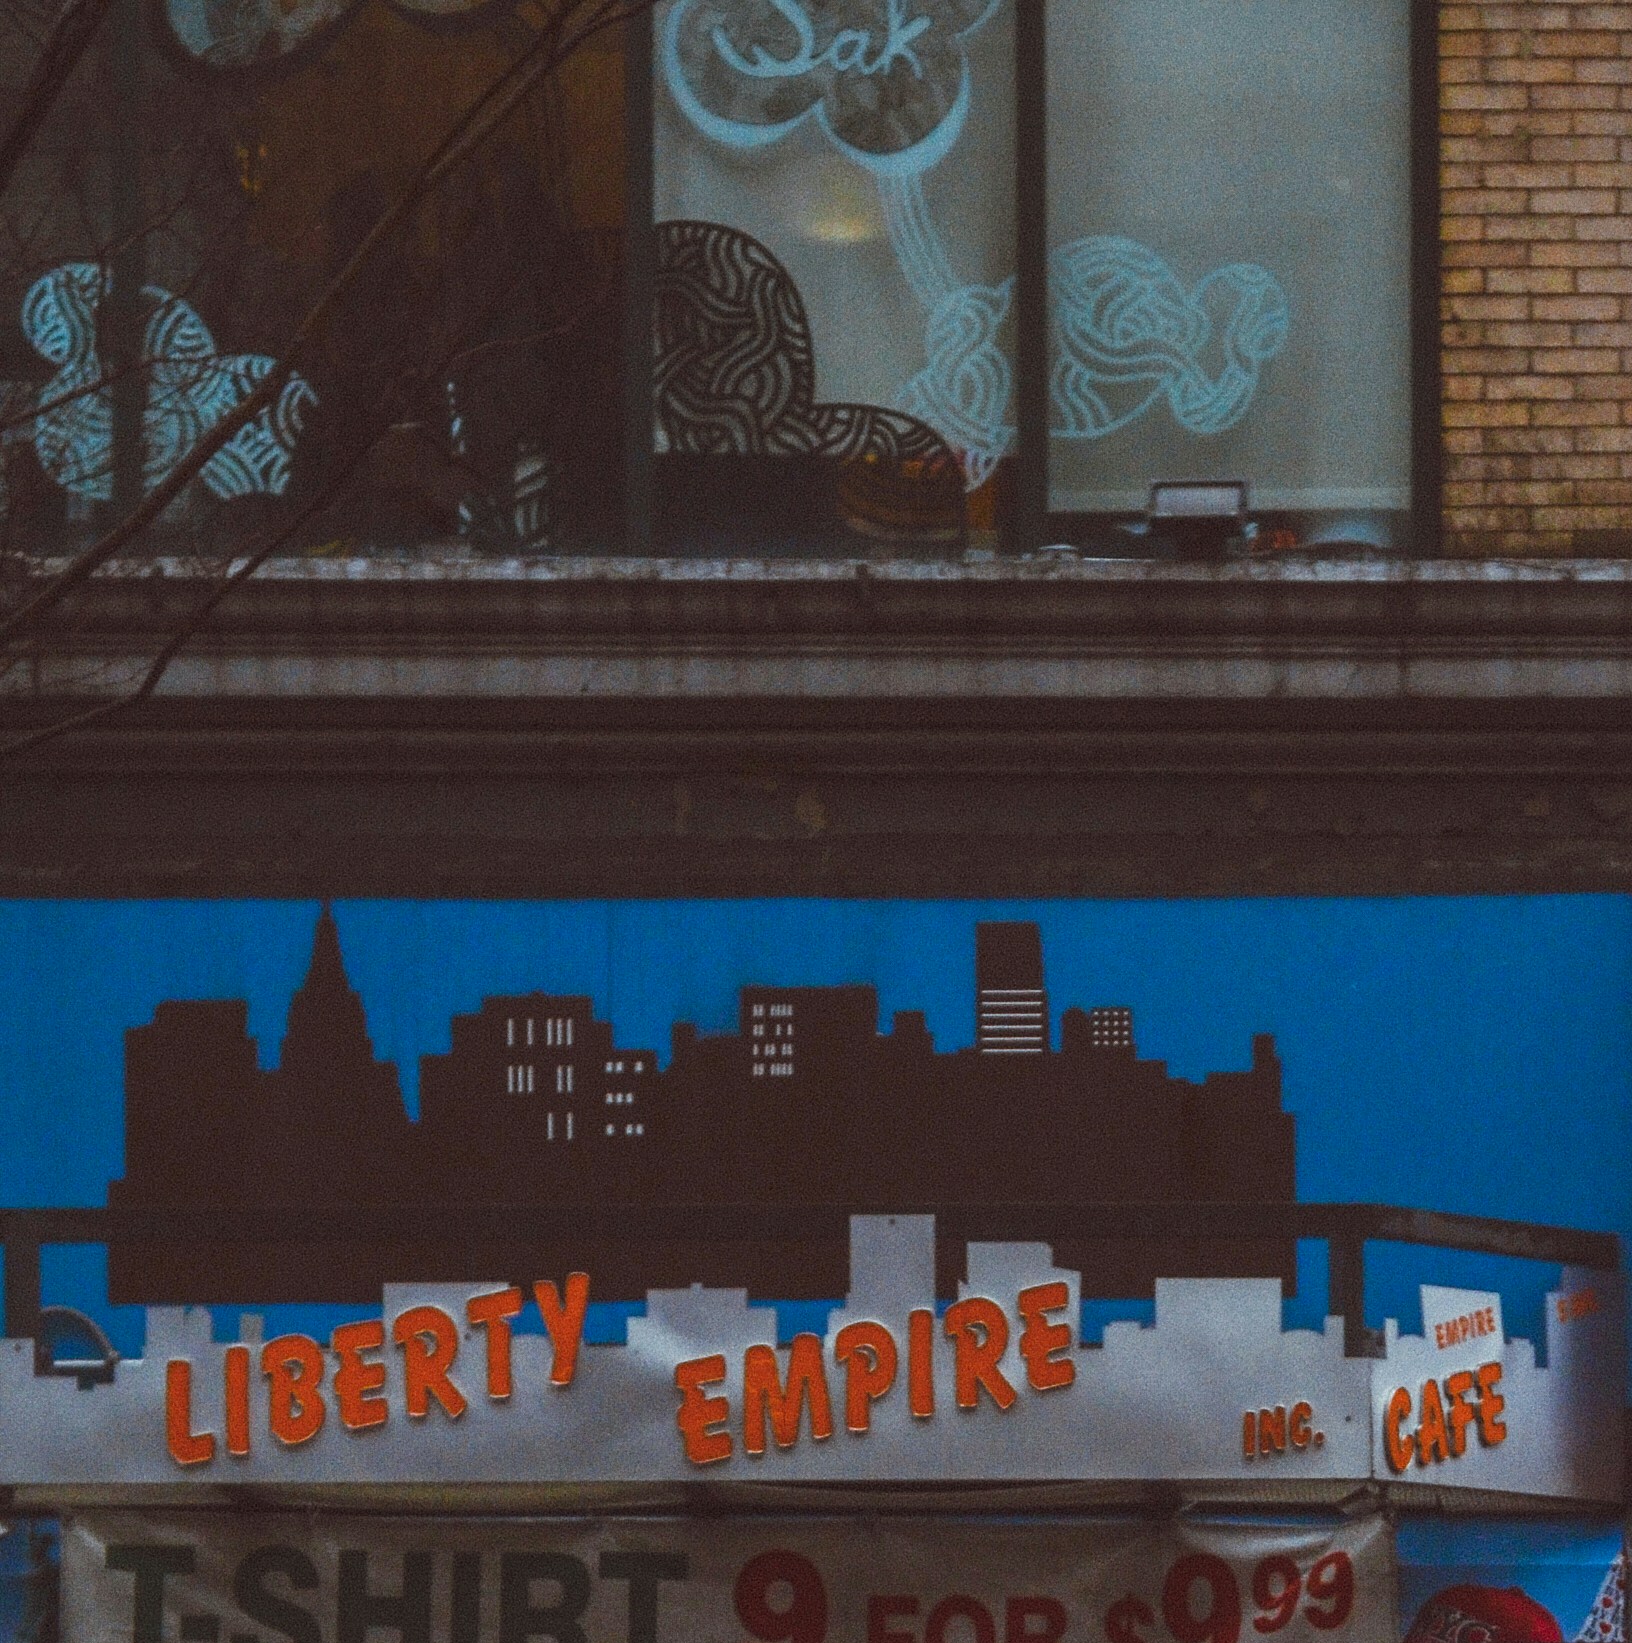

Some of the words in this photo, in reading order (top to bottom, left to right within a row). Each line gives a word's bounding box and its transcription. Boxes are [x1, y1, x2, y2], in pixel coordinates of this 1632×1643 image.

[163, 1271, 591, 1466] LIBERTY
[674, 1281, 1076, 1465] EMPIRE
[1243, 1400, 1326, 1458] INC.
[1434, 1306, 1497, 1350] EMPIRE
[1384, 1362, 1507, 1475] CAFE
